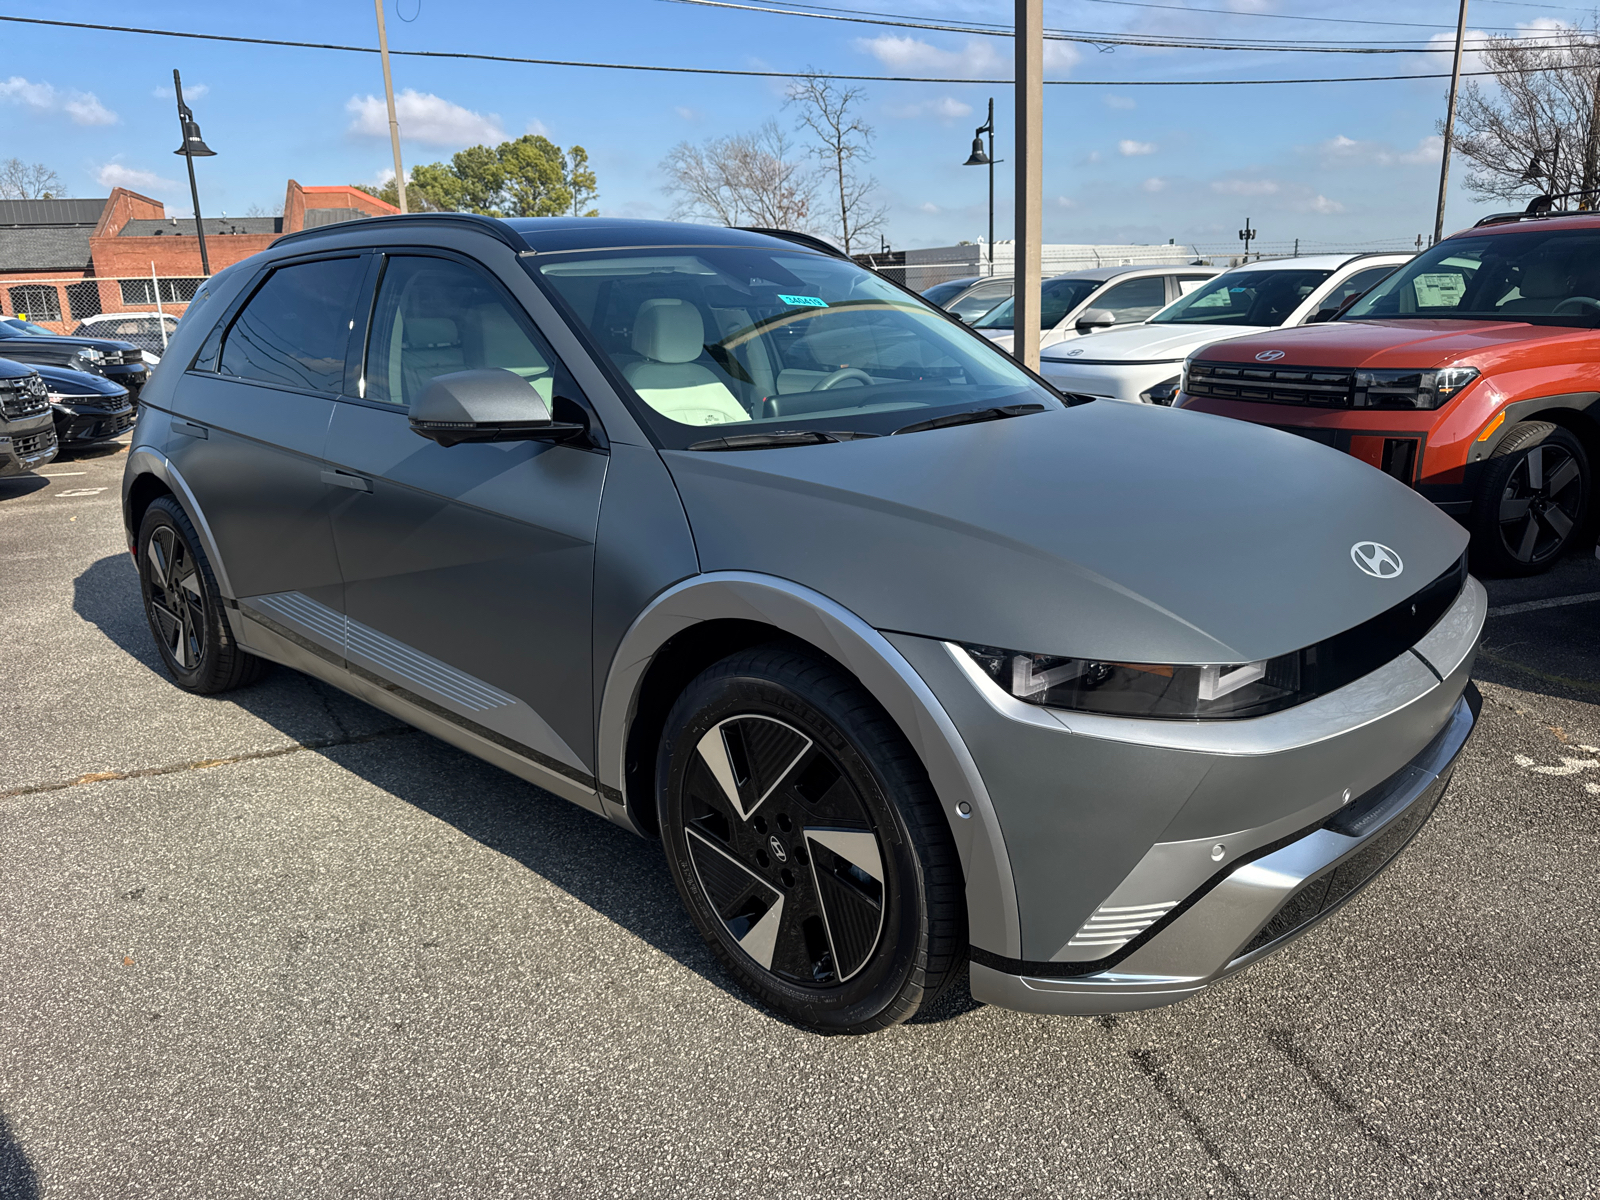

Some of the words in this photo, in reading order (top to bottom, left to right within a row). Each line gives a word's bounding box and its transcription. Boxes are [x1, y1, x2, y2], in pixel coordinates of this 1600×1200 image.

[785, 296, 823, 306] 340419
[762, 688, 844, 747] MICHELIN
[711, 943, 780, 1007] MICHELIN
